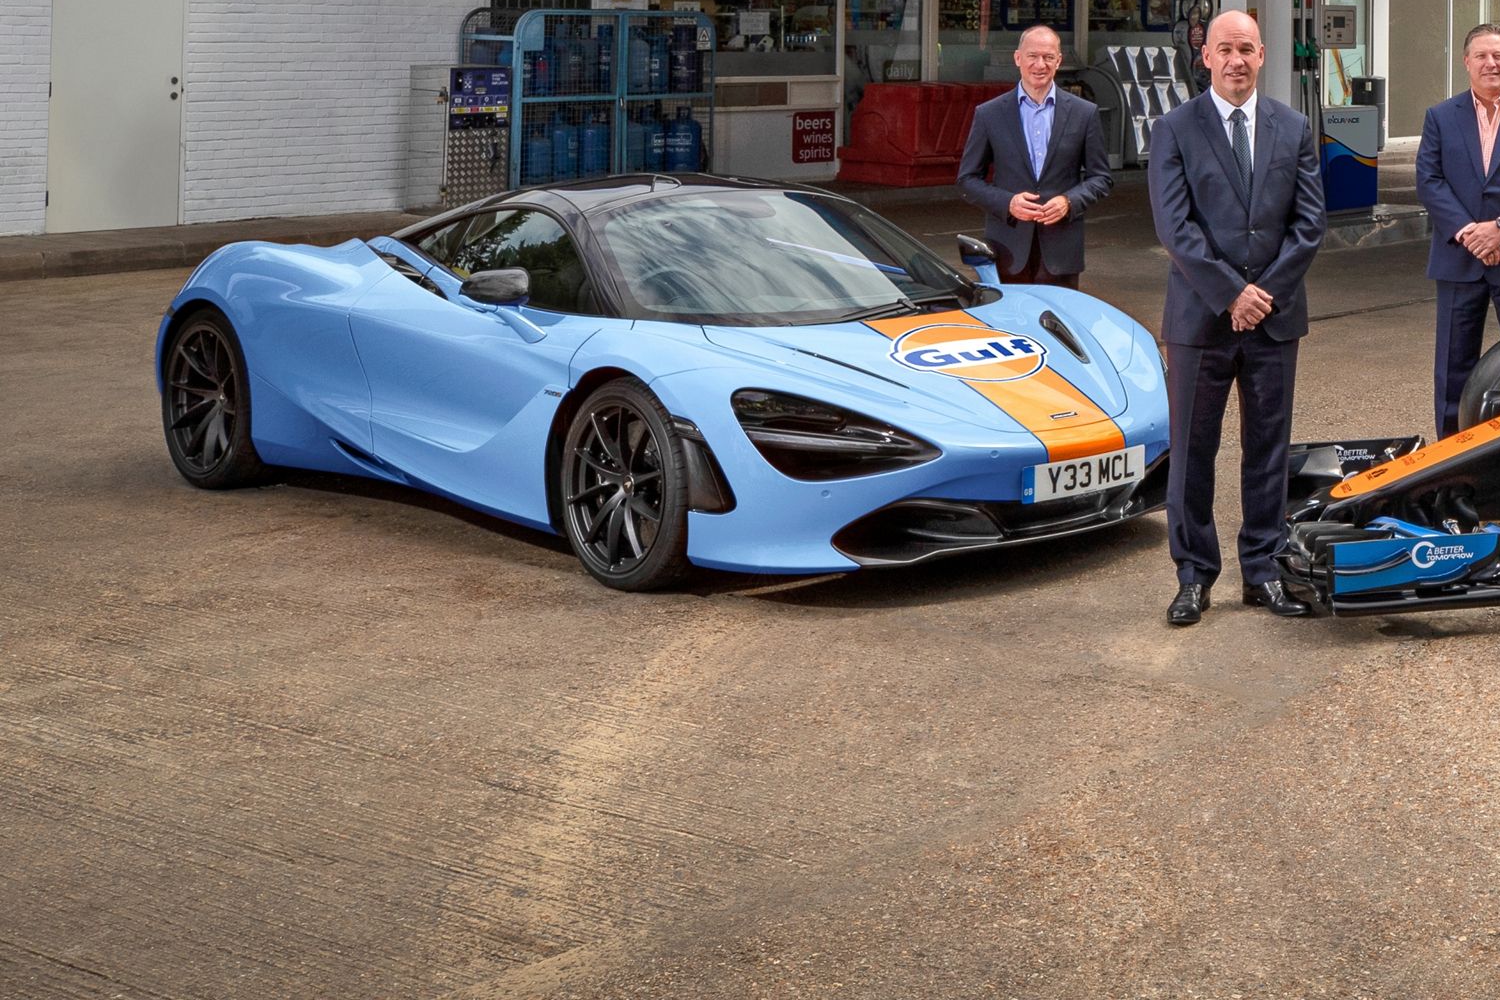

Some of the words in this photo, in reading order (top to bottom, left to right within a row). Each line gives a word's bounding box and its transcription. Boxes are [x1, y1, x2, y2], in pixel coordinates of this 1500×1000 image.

[886, 64, 914, 79] daily
[796, 116, 832, 130] beers
[803, 131, 833, 144] wines
[799, 146, 832, 161] spirits
[905, 337, 1036, 368] Gulf
[1344, 448, 1368, 456] BETTER
[1048, 462, 1092, 494] Y33
[1099, 453, 1135, 484] MCL
[1023, 487, 1033, 497] GB
[1426, 547, 1433, 555] A
[1434, 545, 1465, 555] BETTER
[1426, 552, 1474, 562] TOMORROW
